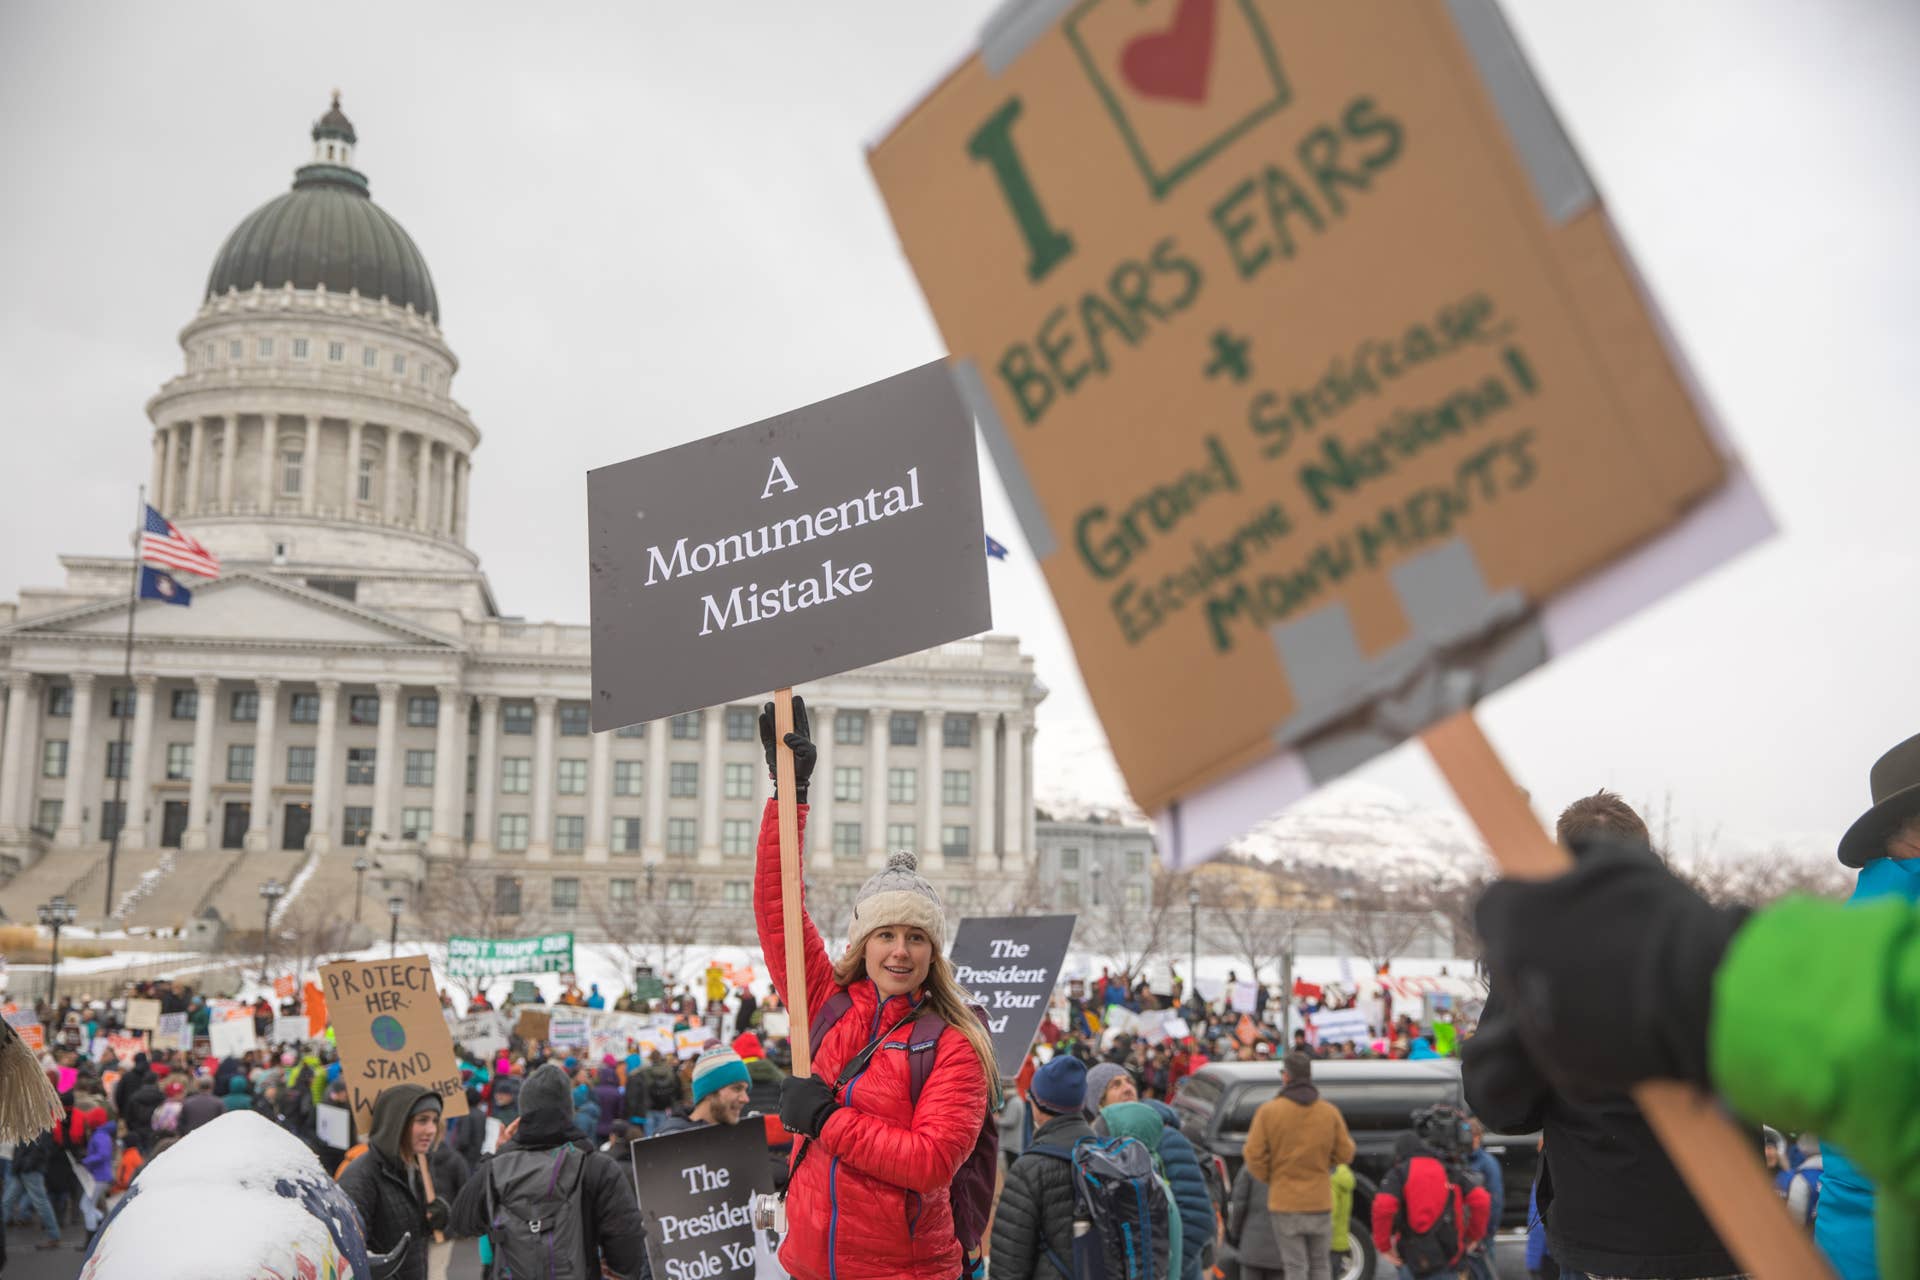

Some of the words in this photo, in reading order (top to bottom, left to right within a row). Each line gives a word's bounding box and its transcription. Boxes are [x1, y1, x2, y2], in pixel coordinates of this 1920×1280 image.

[967, 97, 1075, 283] I
[995, 239, 1203, 425] BEARS
[1211, 96, 1405, 281] EARS
[1204, 329, 1253, 386] +
[1299, 346, 1539, 513] National
[761, 457, 798, 499] A
[645, 467, 923, 585] Monumental
[1073, 435, 1241, 581] Grand
[1206, 429, 1539, 653] MONUMENTS
[699, 560, 872, 635] Mistake
[990, 939, 1030, 958] The
[328, 965, 431, 1000] PROTECT
[955, 965, 1048, 983] President
[993, 991, 1041, 1008] Your
[363, 1052, 431, 1080] STAND
[432, 1077, 464, 1099] HER
[682, 1164, 730, 1195] The
[665, 1250, 723, 1280] Stole
